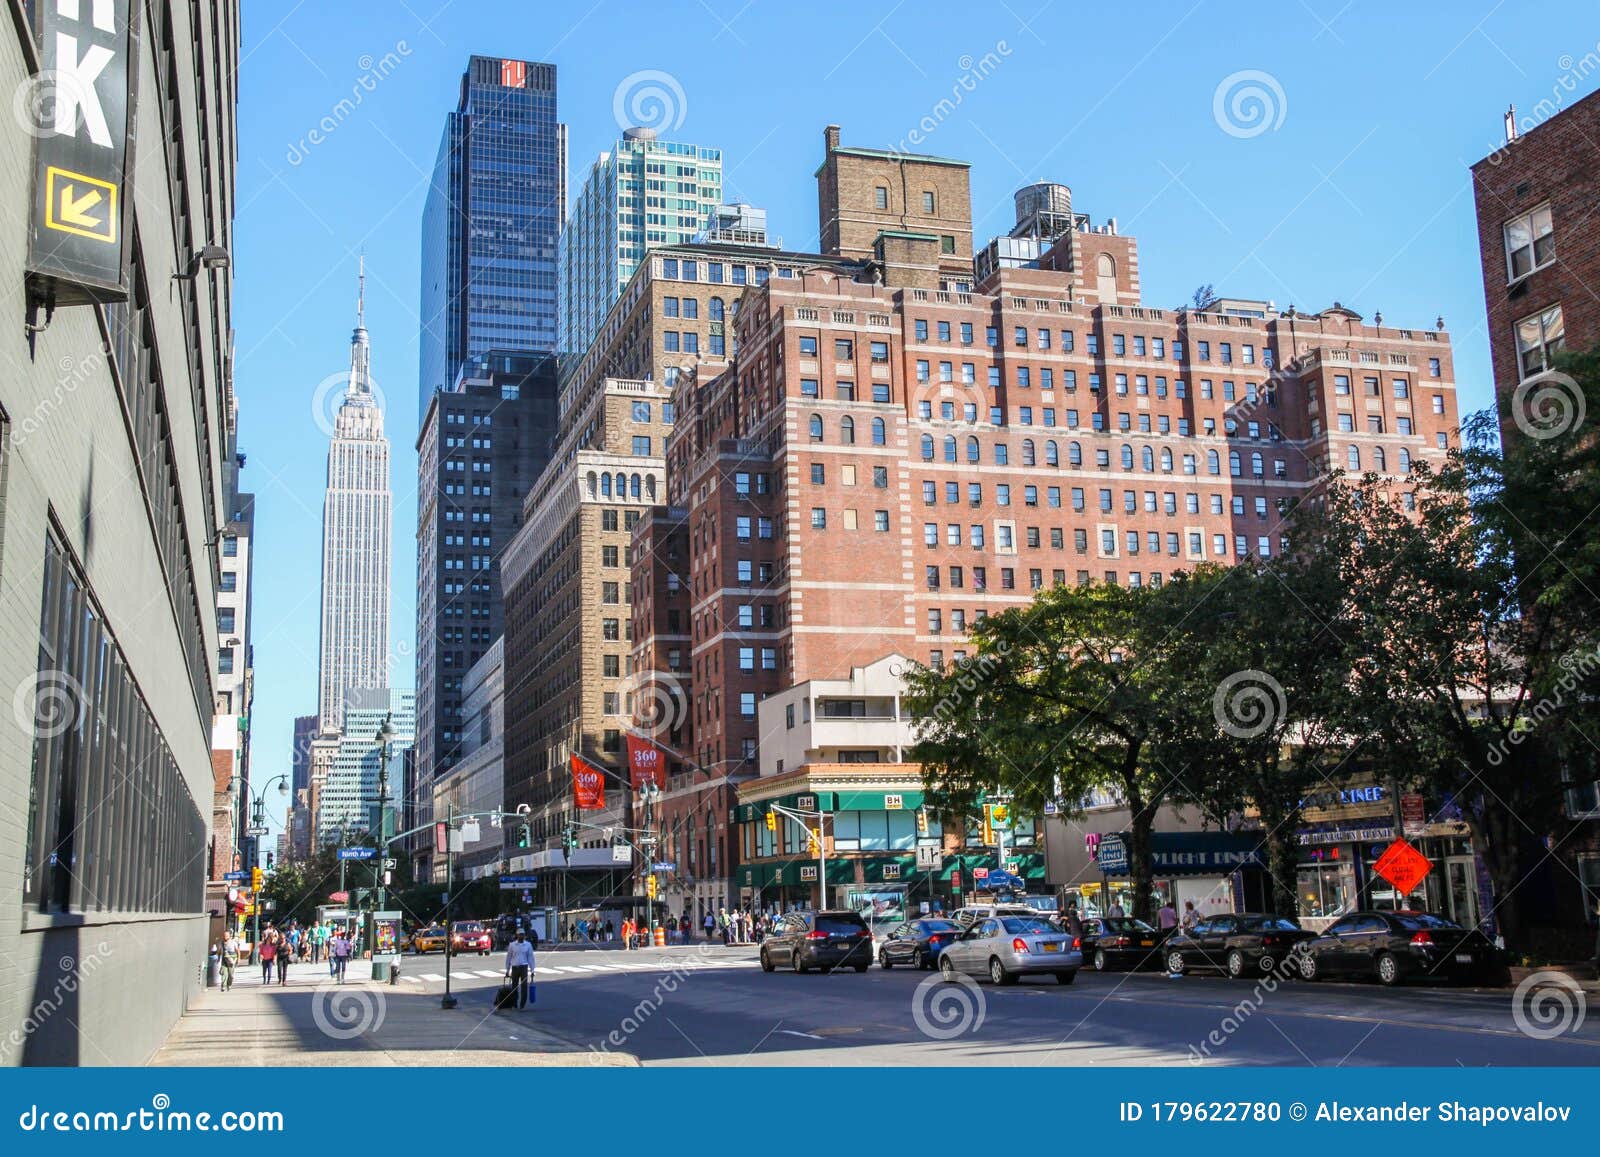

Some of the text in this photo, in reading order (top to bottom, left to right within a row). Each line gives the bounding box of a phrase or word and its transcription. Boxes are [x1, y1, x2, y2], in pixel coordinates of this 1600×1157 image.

[634, 750, 657, 761] 360
[577, 773, 598, 783] 360
[800, 798, 812, 806] BH
[802, 867, 816, 876] BH
[885, 865, 898, 873] BH
